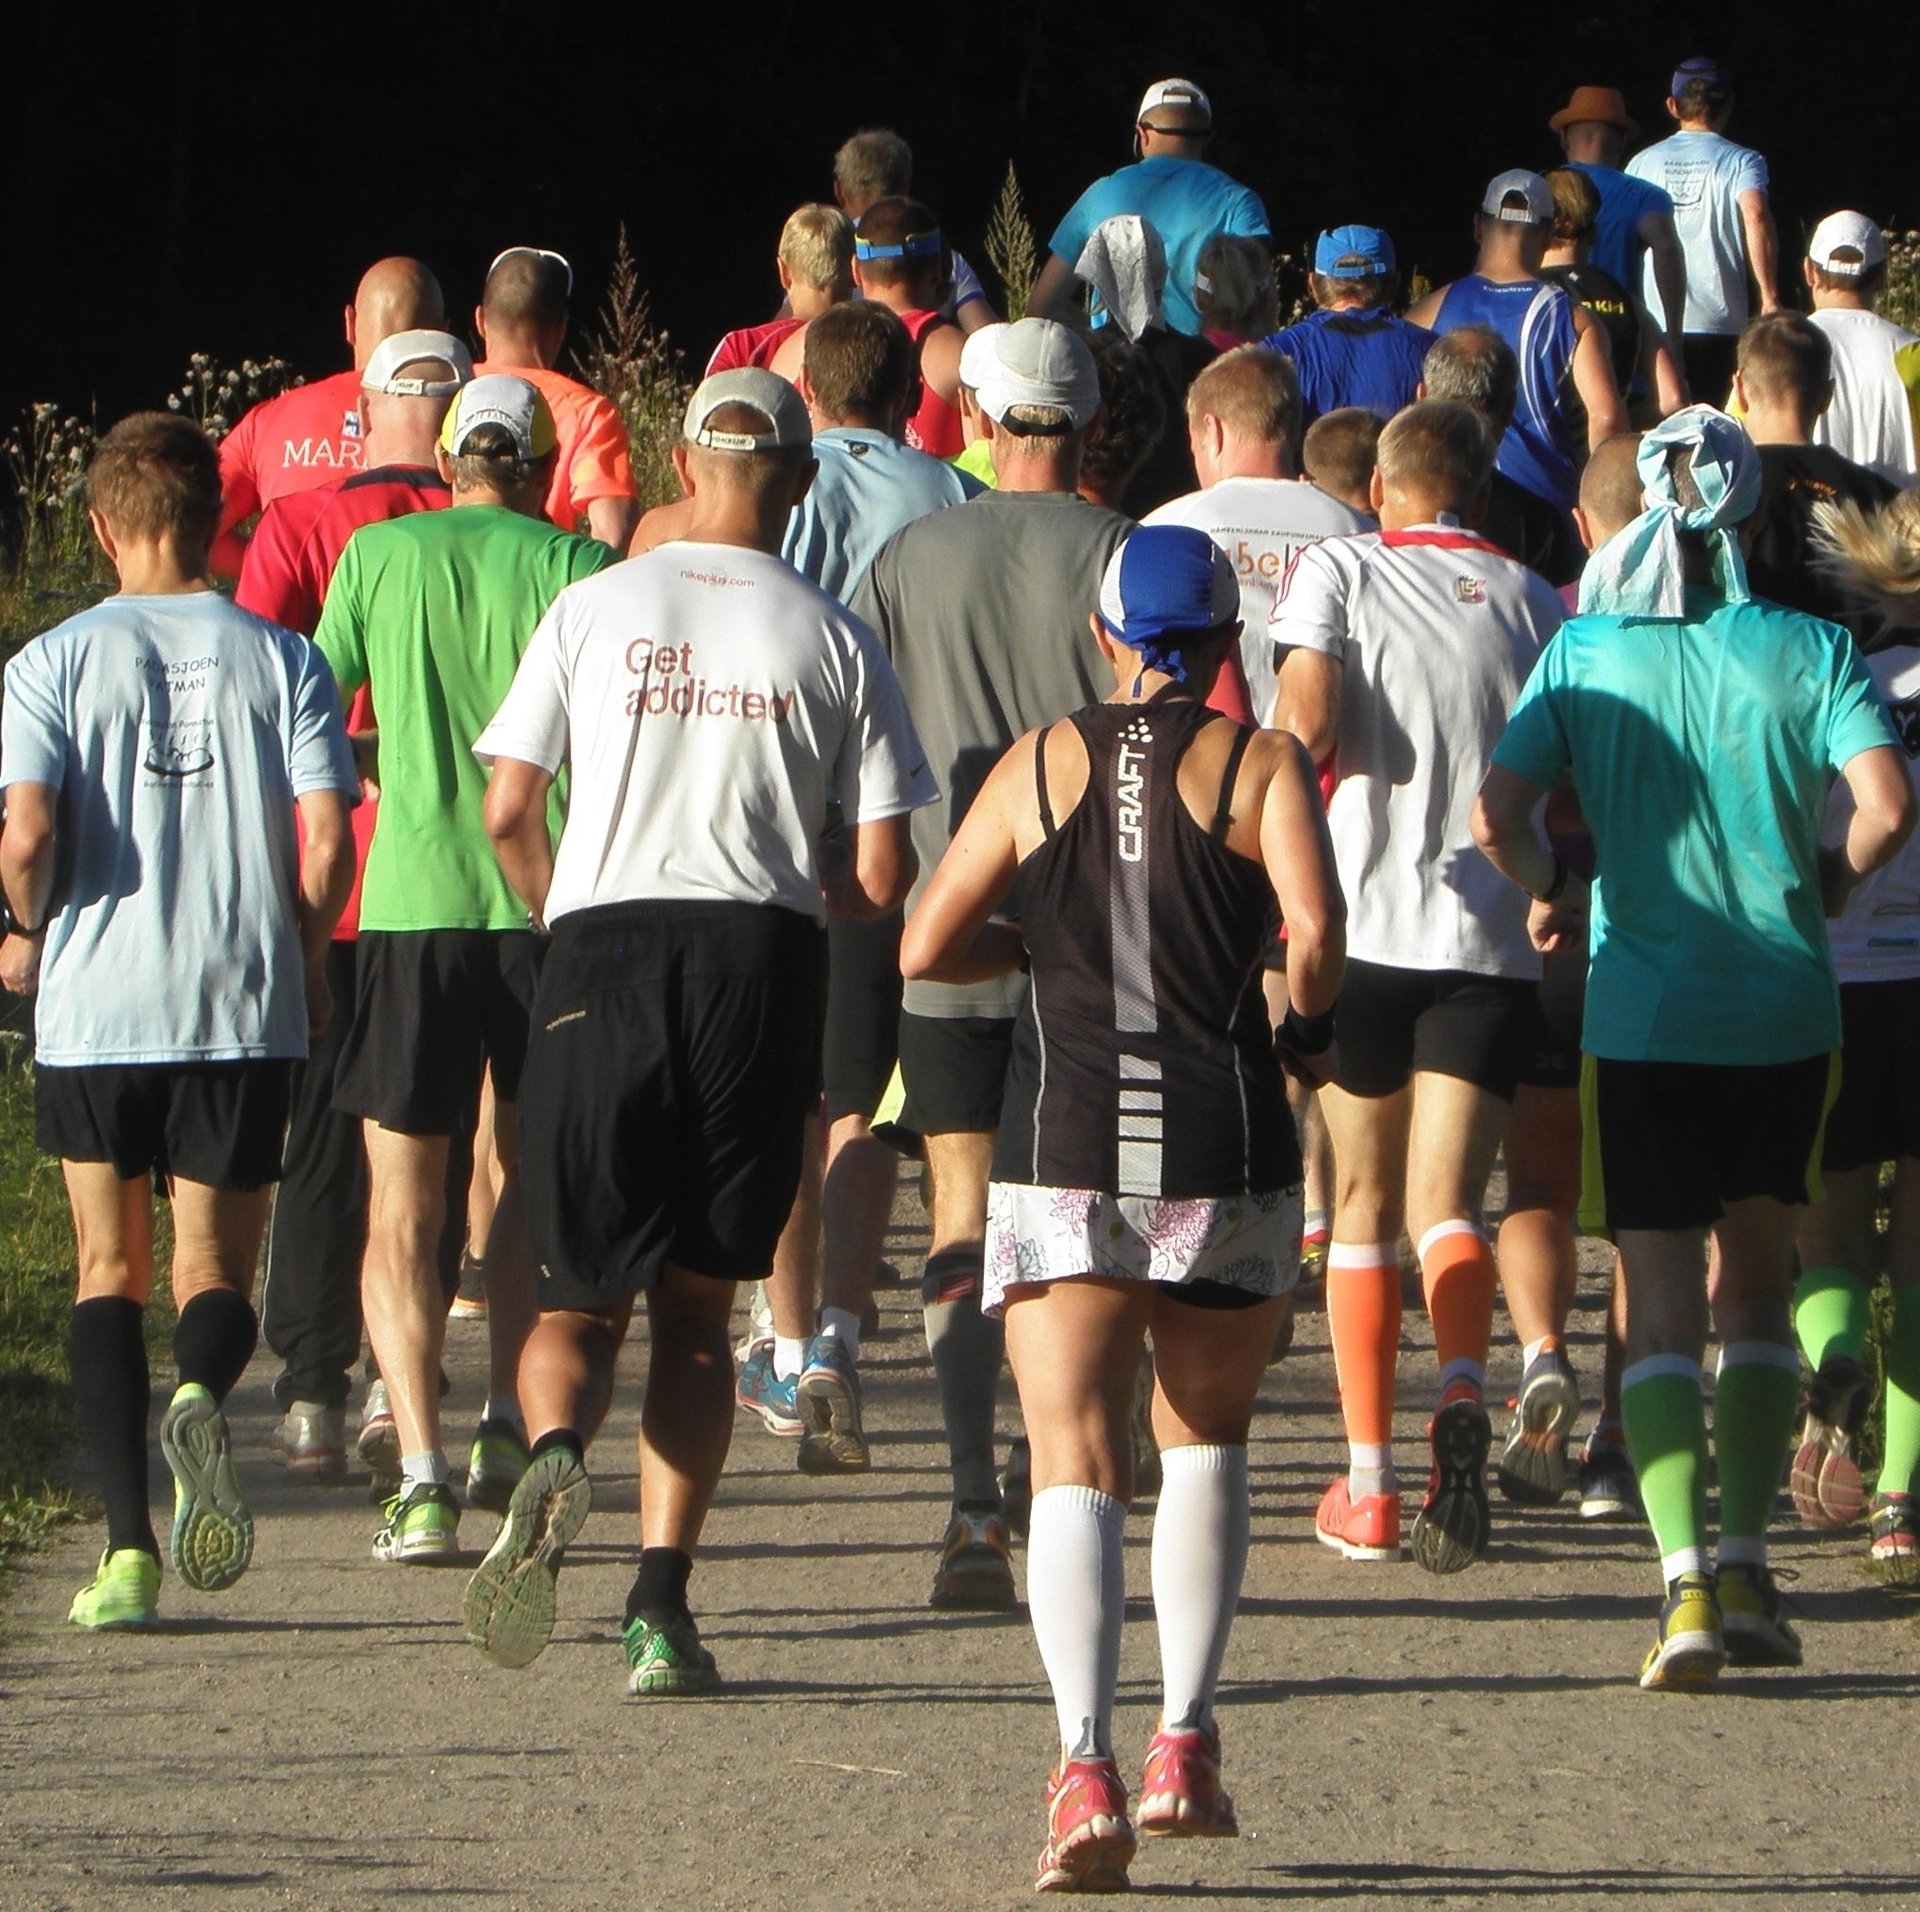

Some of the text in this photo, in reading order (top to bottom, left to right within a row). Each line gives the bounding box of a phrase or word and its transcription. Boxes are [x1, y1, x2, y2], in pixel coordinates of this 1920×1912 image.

[680, 568, 755, 587] nikeplus.com
[626, 638, 692, 675] Get
[625, 676, 795, 723] addicted
[1117, 743, 1146, 862] CRAFT
